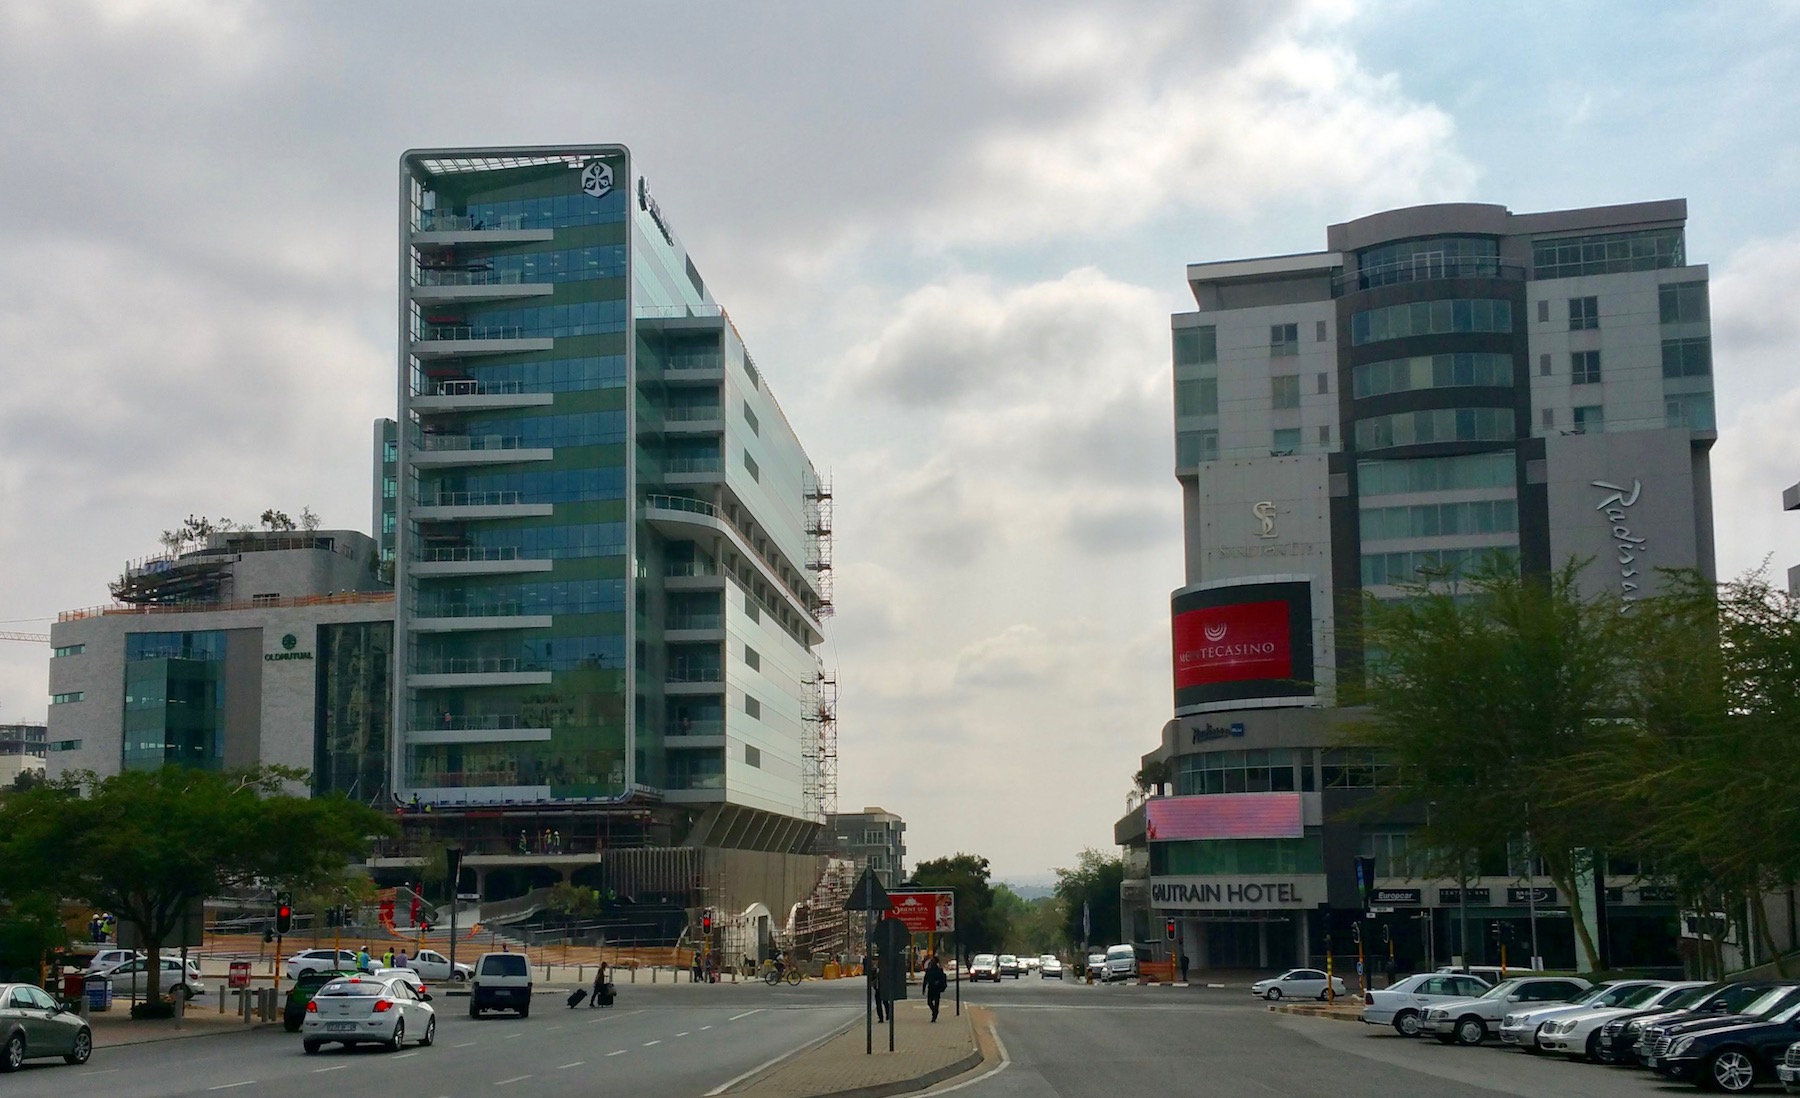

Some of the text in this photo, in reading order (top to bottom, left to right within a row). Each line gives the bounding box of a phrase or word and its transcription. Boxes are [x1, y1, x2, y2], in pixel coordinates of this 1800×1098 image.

[1152, 883, 1221, 903] GAUTRAIN
[1227, 883, 1303, 903] HOTEL
[1378, 891, 1413, 901] Europcar
